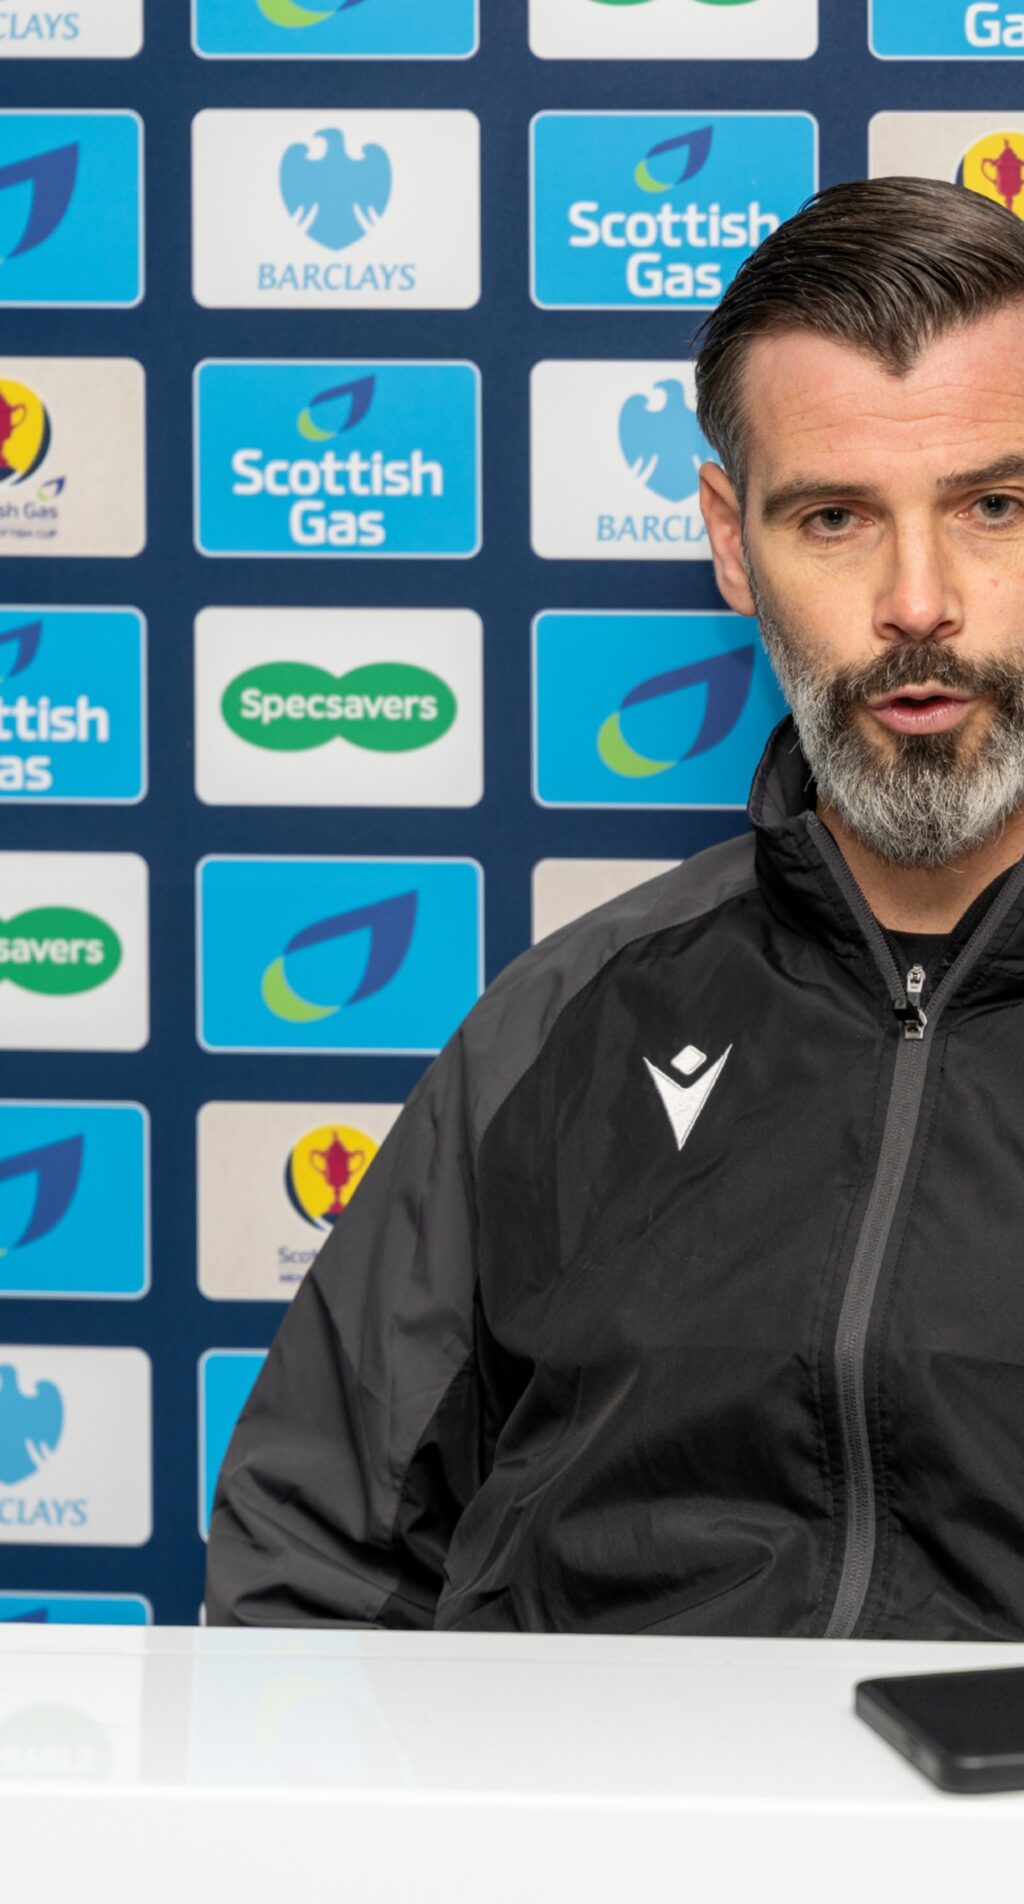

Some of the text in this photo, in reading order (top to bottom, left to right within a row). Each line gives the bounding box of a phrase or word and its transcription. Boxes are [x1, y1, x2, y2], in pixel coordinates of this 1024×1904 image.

[568, 201, 780, 247] Scottish
[257, 264, 416, 291] BARCLAYS
[626, 253, 723, 298] Gas
[231, 449, 444, 497] Scottish
[289, 500, 386, 547] Gas
[240, 687, 439, 725] Specsavers
